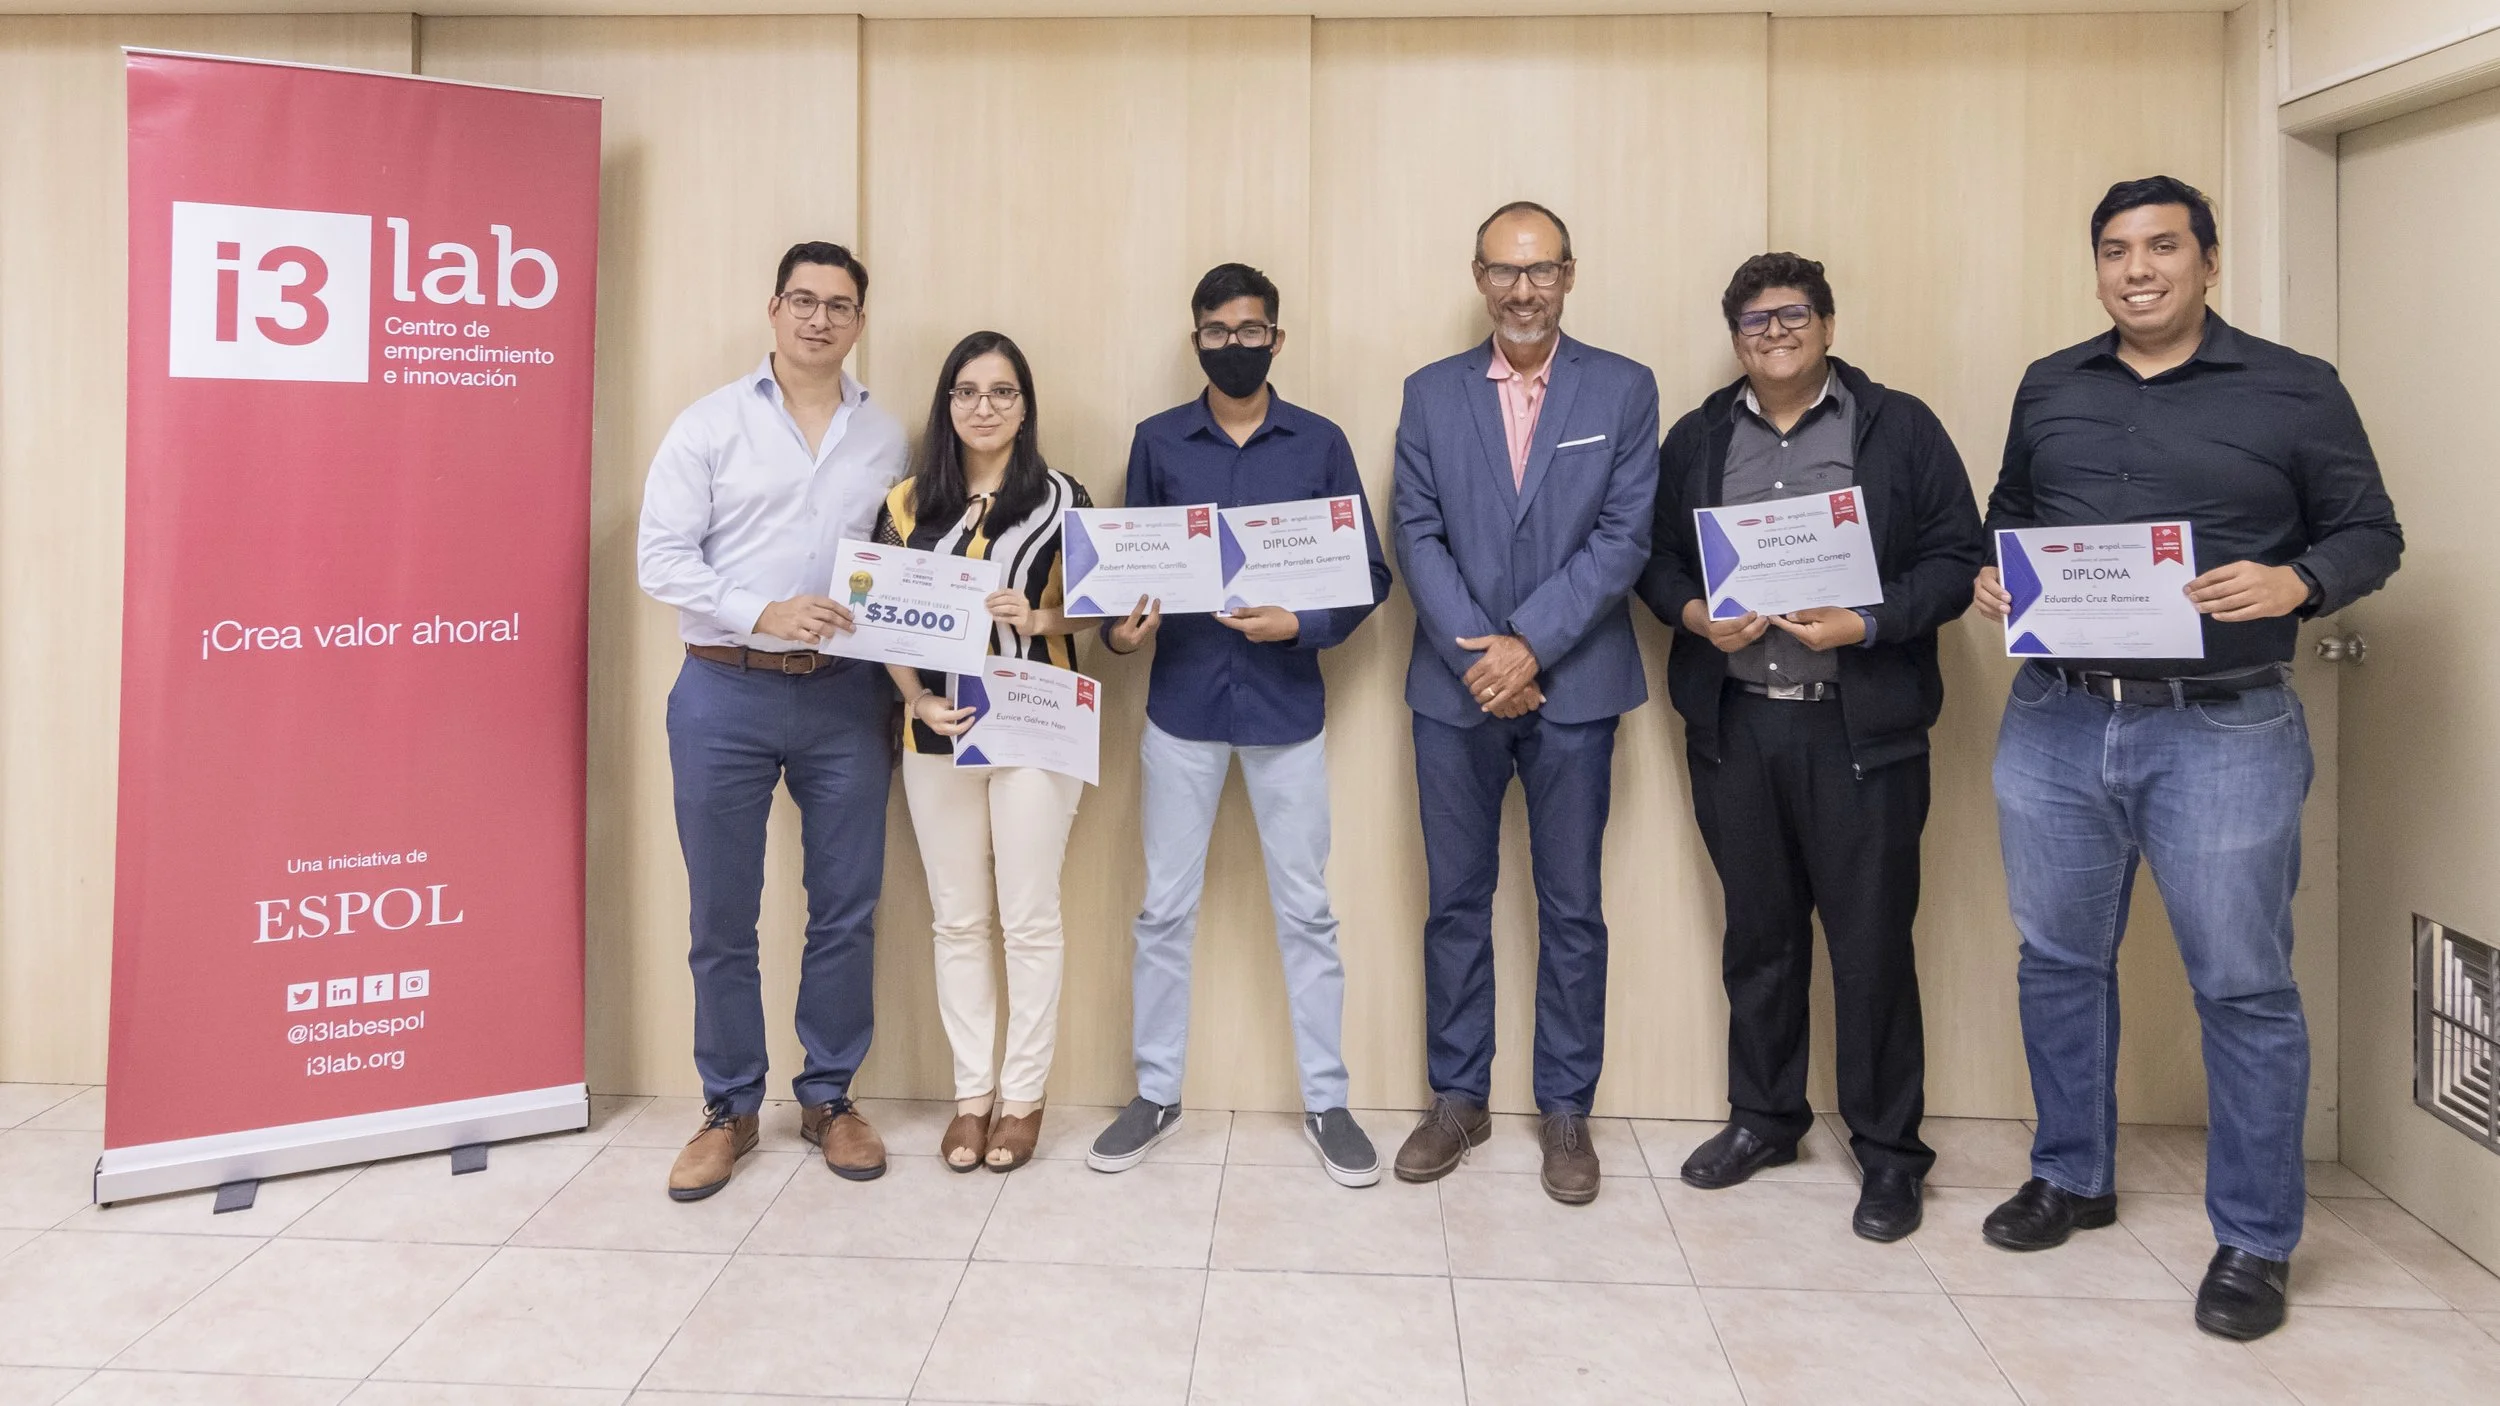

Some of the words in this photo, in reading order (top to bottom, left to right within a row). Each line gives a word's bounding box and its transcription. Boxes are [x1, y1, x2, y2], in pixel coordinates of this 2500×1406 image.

[215, 241, 330, 346] i3
[386, 216, 559, 310] lab
[384, 316, 457, 337] Centro
[463, 320, 490, 338] de
[383, 344, 555, 365] emprendimiento
[383, 370, 397, 384] e
[403, 366, 517, 387] innovación
[1115, 541, 1171, 553] DIPLOMA
[1262, 535, 1318, 550] DIPLOMA
[1757, 532, 1818, 549] DIPLOMA
[1158, 561, 1187, 570] Carrillo
[1245, 562, 1281, 571] Katherine
[1283, 557, 1314, 567] Parrales
[1315, 554, 1351, 564] Guerrero
[1739, 561, 1777, 572] Jonathan
[2062, 568, 2131, 580] DIPLOMA
[2044, 594, 2083, 603] Eduardo
[2085, 594, 2109, 603] Cruz
[865, 602, 955, 632] $3.000
[202, 620, 303, 660] ¡Crea
[313, 616, 403, 648] valor
[412, 612, 519, 645] ahora!
[1008, 691, 1060, 710] DIPLOMA
[996, 712, 1022, 721] Eunice
[287, 858, 323, 874] Una
[328, 851, 402, 870] iniciativa
[405, 848, 428, 864] de
[252, 884, 464, 944] ESPOL
[287, 1010, 425, 1045] @i3labespol
[306, 1050, 405, 1077] i3lab.org
